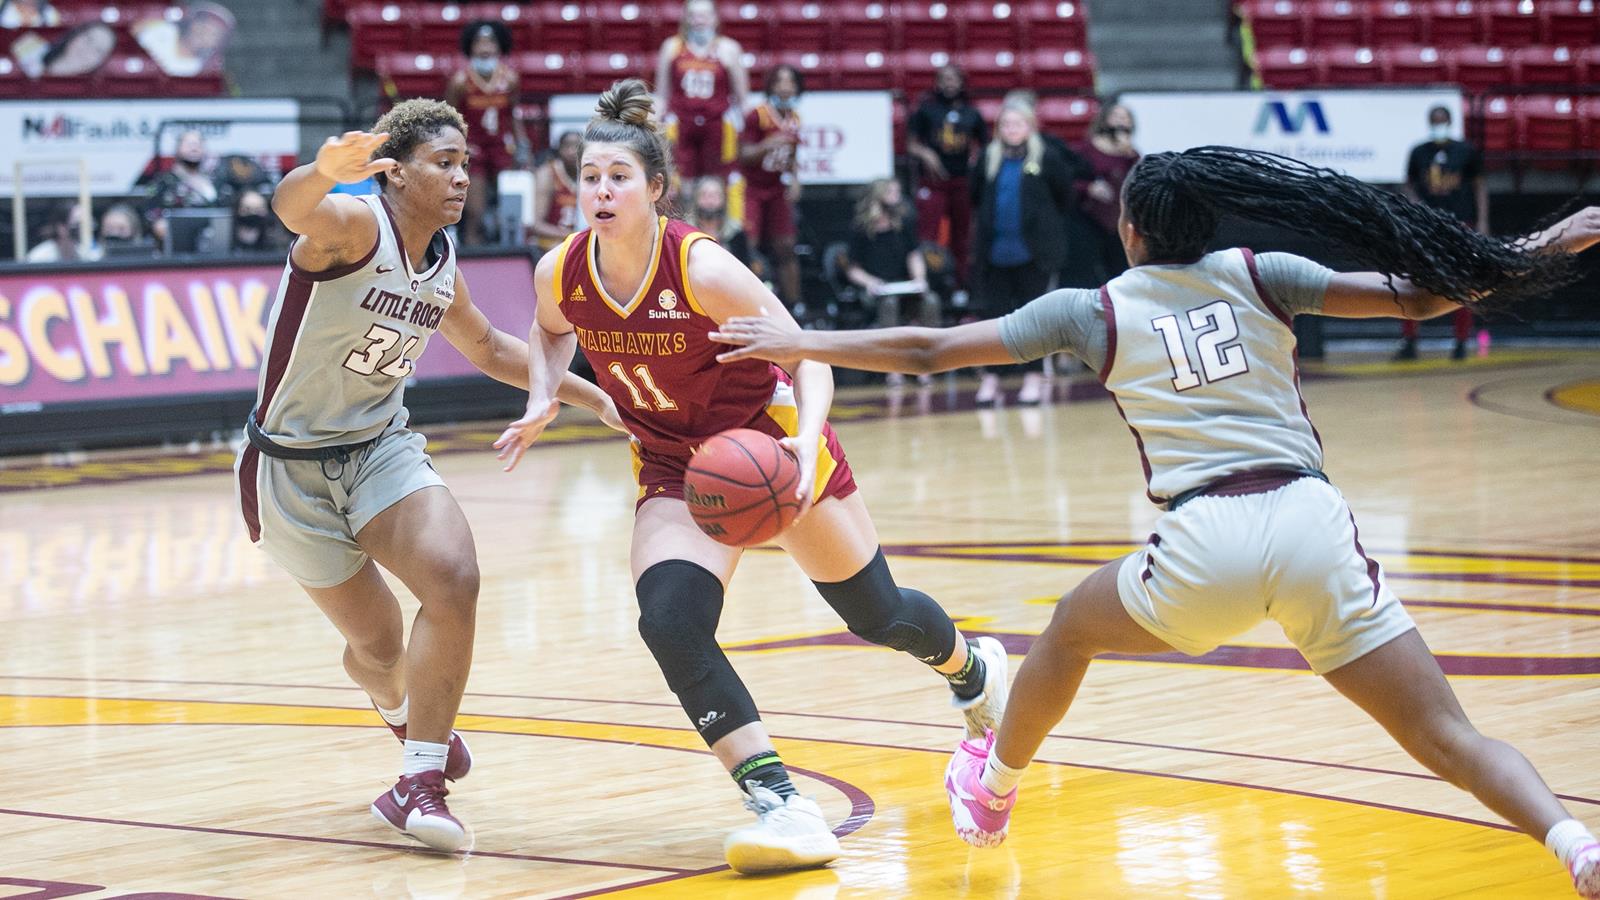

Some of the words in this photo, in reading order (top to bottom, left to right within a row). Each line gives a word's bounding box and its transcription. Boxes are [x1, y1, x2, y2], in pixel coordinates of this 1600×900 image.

[360, 287, 411, 320] LITTLE
[575, 326, 686, 355] WARHAWKS
[1151, 299, 1249, 393] 12
[608, 361, 680, 412] 11
